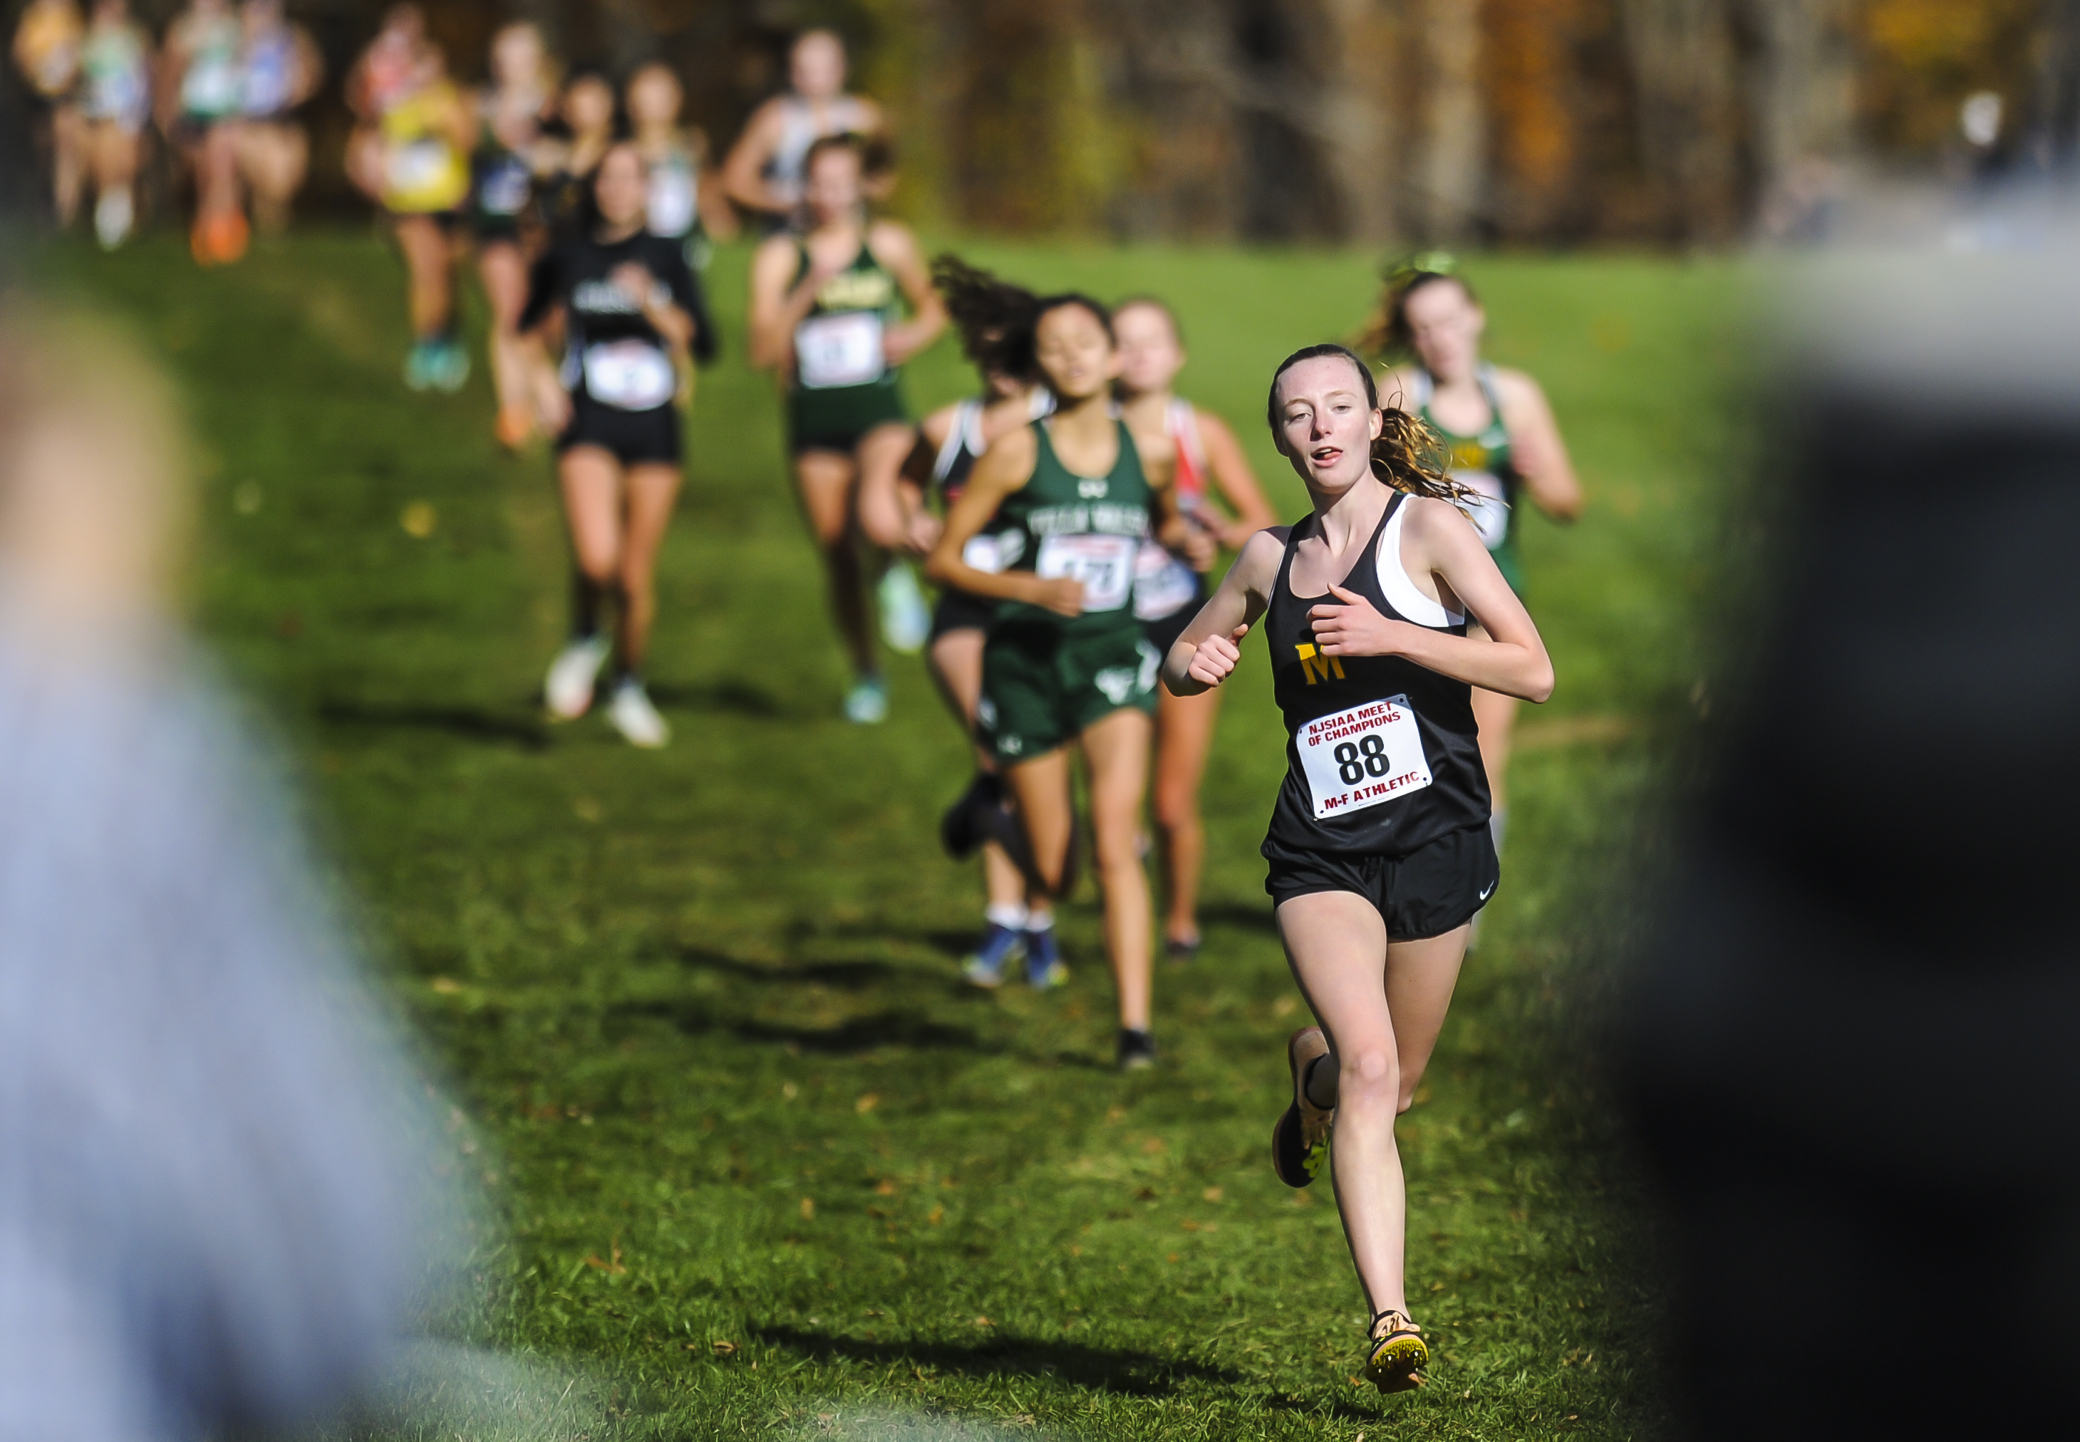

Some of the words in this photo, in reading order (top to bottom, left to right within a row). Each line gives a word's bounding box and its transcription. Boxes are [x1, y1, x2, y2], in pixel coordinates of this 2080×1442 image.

[1295, 643, 1346, 685] M
[1308, 713, 1356, 735] NJSIAA
[1358, 701, 1392, 720] MEET
[1308, 735, 1321, 747] OF
[1325, 711, 1401, 742] CHAMPIONS
[1333, 734, 1391, 786] 88
[1324, 793, 1349, 810] M-F
[1353, 771, 1420, 802] ATHLETIC
